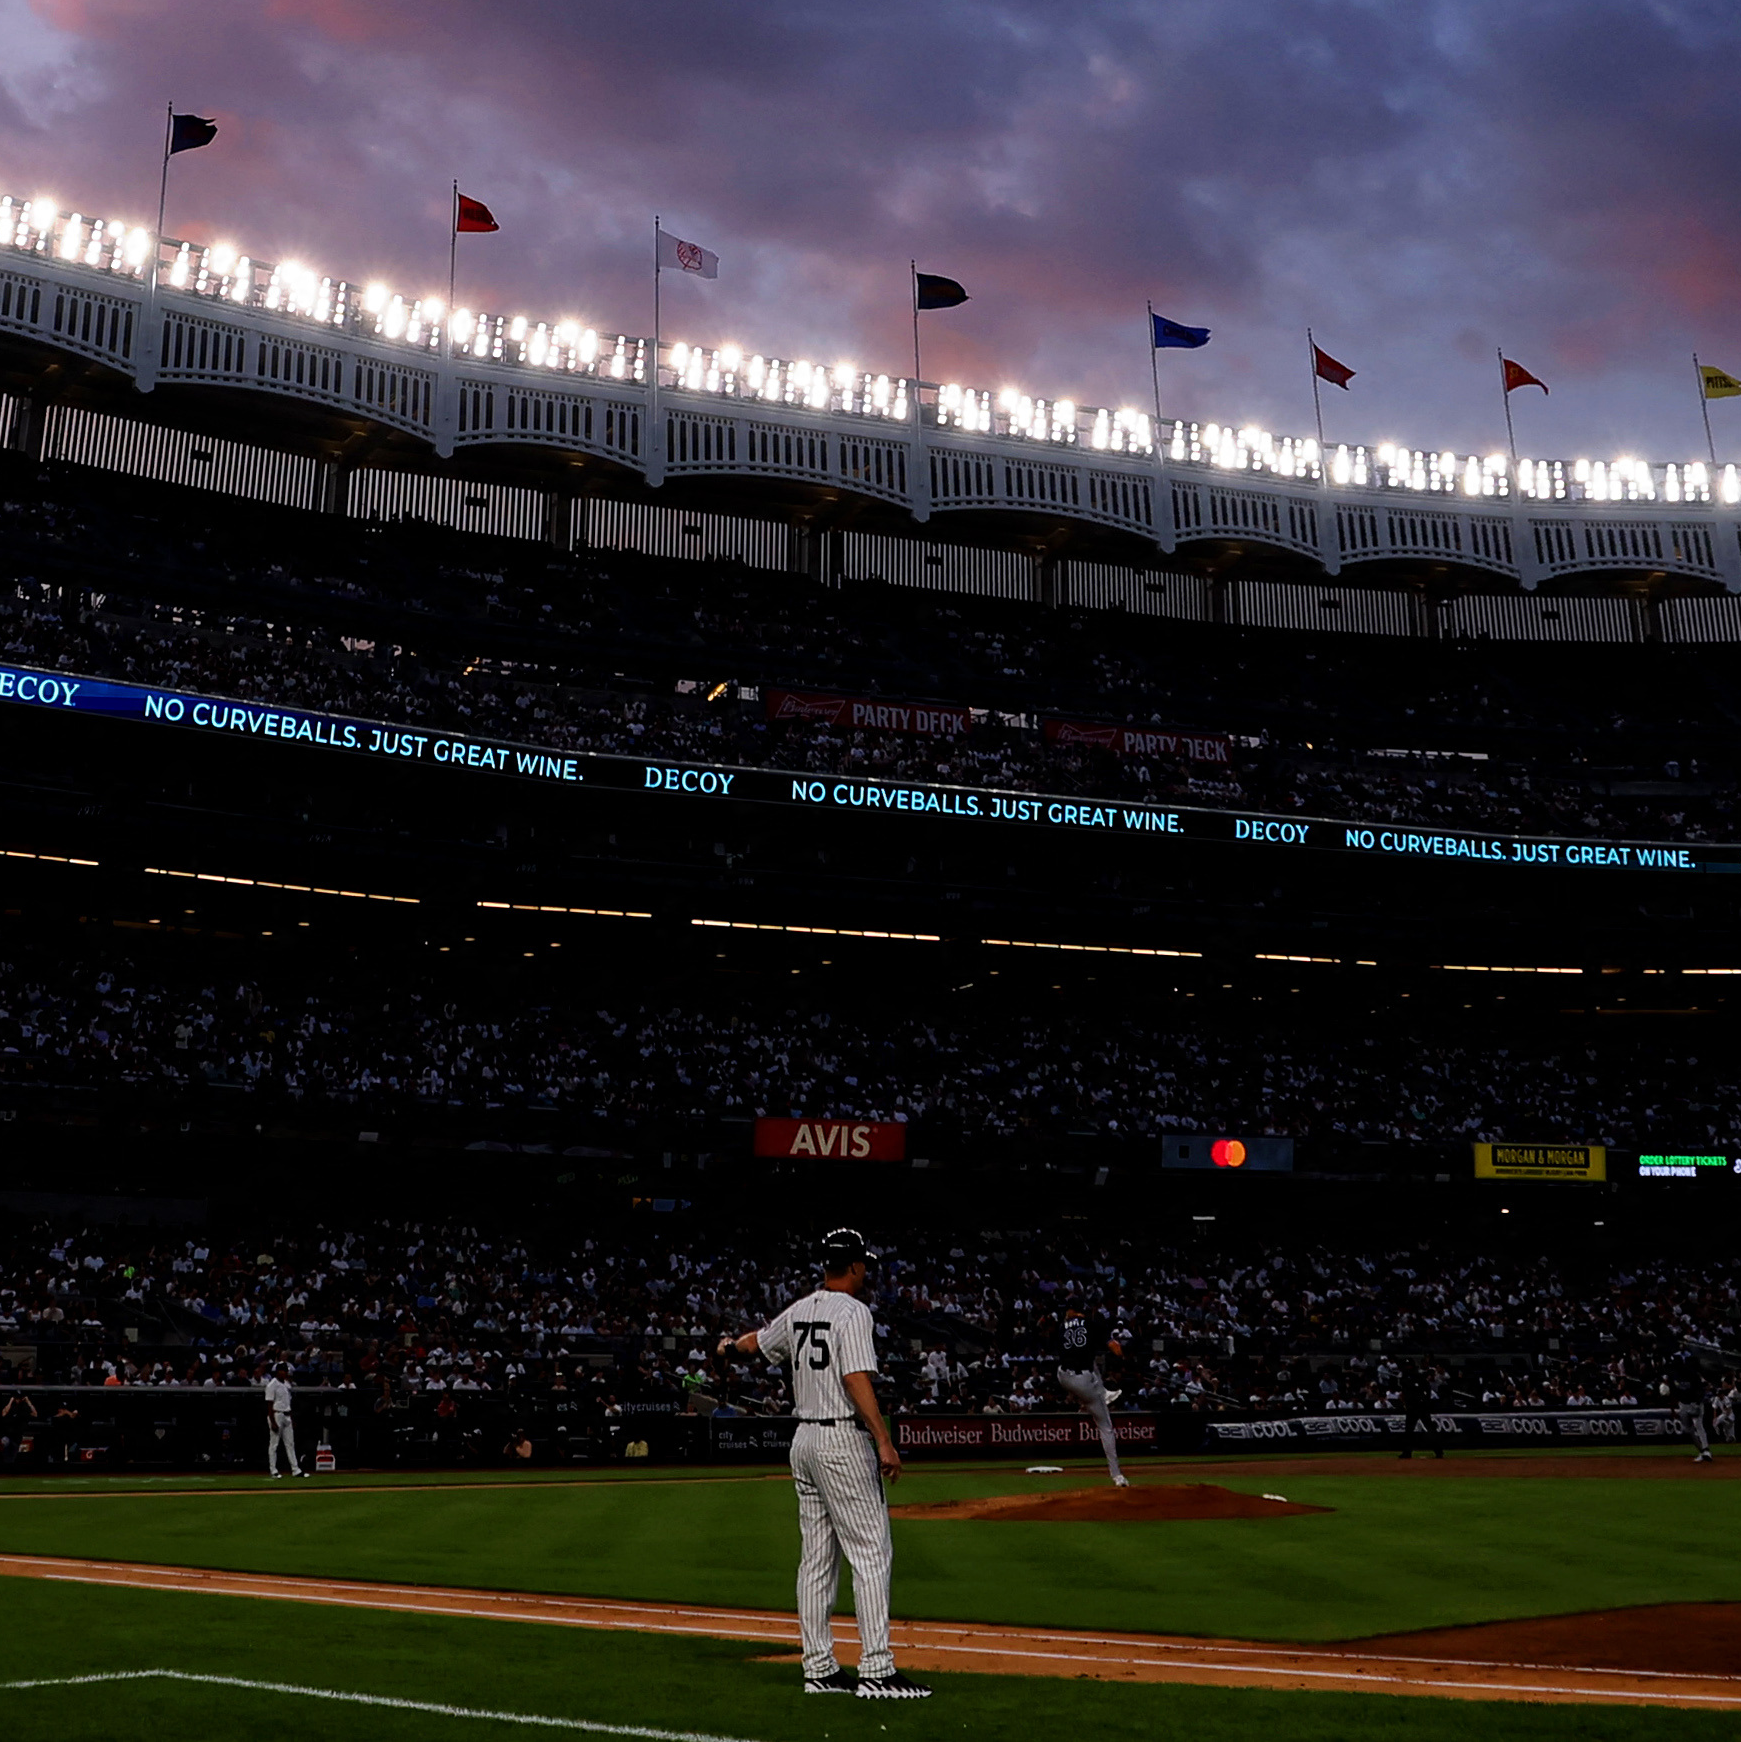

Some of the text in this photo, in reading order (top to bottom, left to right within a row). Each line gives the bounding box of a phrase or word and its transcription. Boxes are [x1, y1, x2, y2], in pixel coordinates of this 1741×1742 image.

[852, 703, 910, 730] PARTY
[916, 710, 964, 735] DECK
[145, 695, 584, 781] NO CURVEBALLS. JUST GREAT WINE.
[1123, 732, 1177, 754] PARTY
[644, 766, 735, 795] DECOY
[792, 780, 1185, 833] NO CURVEBALLS. JUST GREAT WINE.
[1235, 819, 1309, 844] DECOY
[1345, 828, 1696, 869] NO CURVEBALLS. JUST GREAT WINE.
[789, 1124, 871, 1158] AVIS
[1496, 1149, 1585, 1165] MORGAN & MORGAN
[1639, 1155, 1727, 1166] ORDER LOTTERY TICKETS
[1639, 1166, 1696, 1177] ON YOUR PHONE
[793, 1322, 831, 1370] 75
[899, 1422, 1156, 1445] Budweiser Budweiser Bueiser
[1251, 1421, 1298, 1438] COOL
[1338, 1418, 1381, 1433] COOL
[1512, 1418, 1553, 1435] COOL
[1589, 1418, 1629, 1435] COOL
[1664, 1418, 1682, 1435] CO
